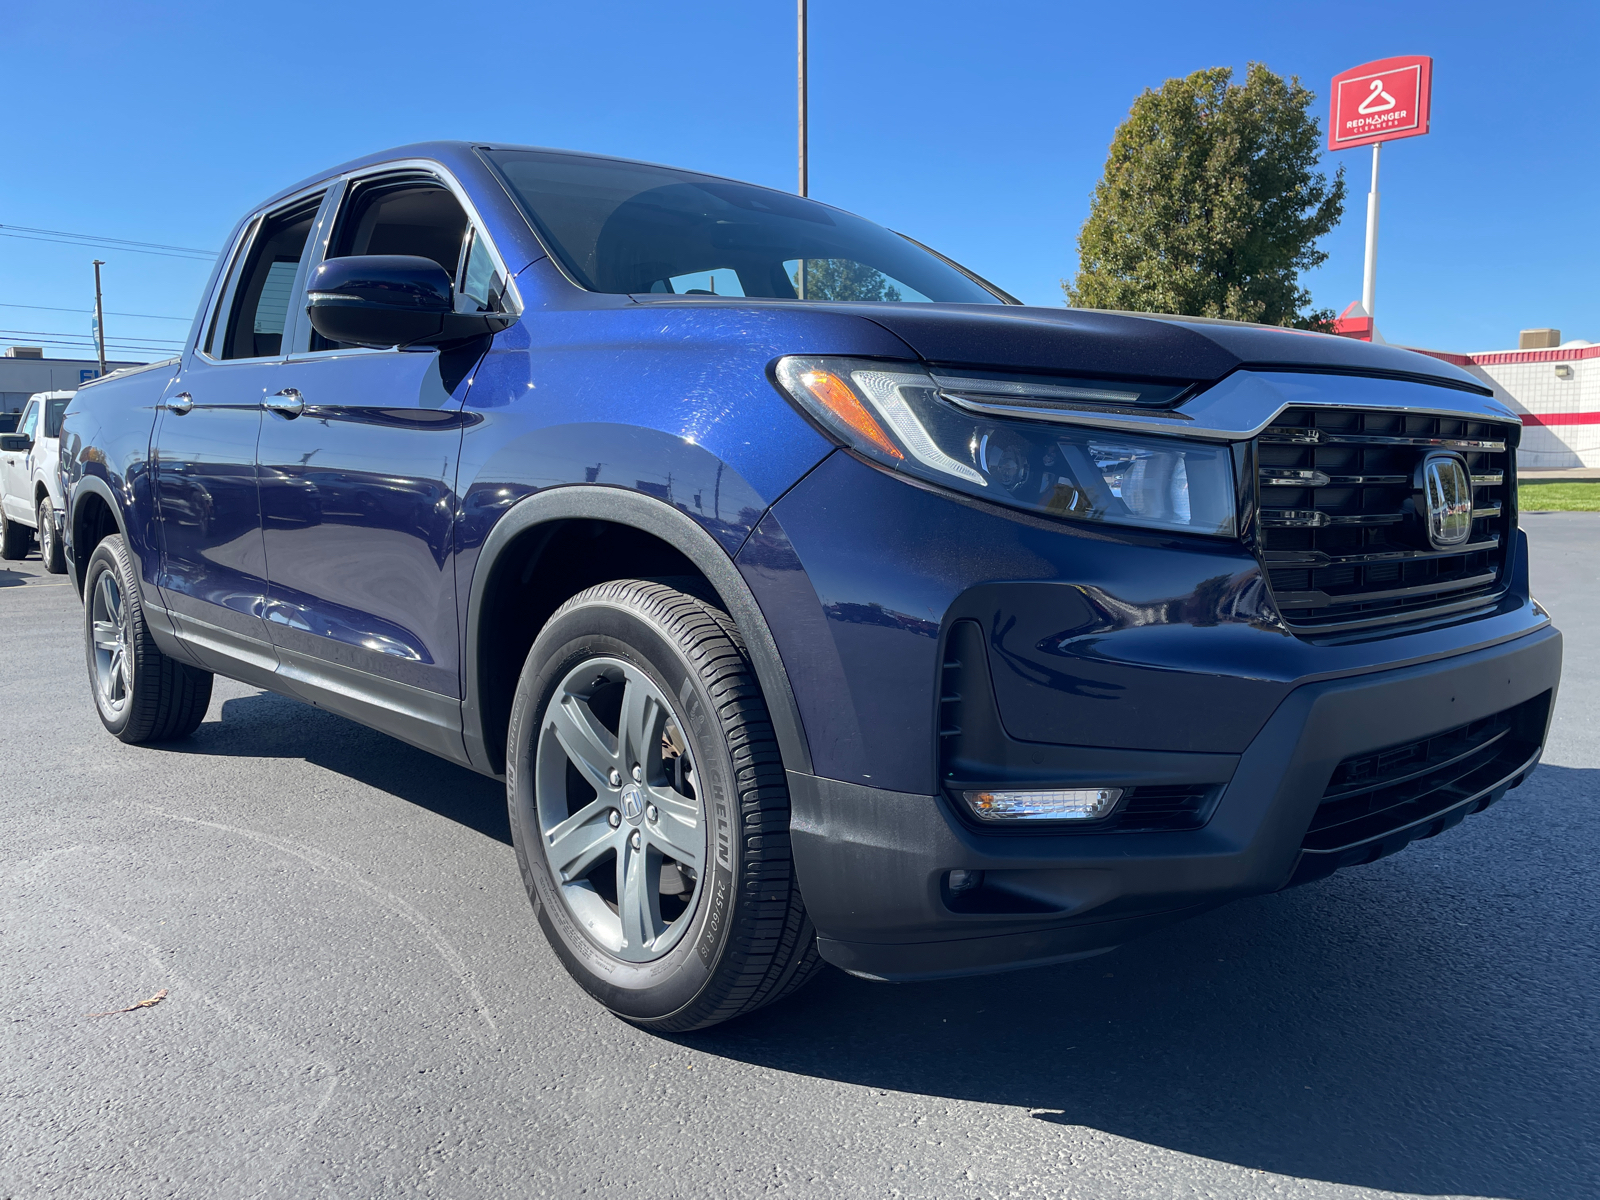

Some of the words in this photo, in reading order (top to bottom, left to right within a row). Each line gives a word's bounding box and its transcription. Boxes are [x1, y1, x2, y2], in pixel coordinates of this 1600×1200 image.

[1346, 119, 1364, 129] RED
[1353, 120, 1399, 133] CLEANERS
[711, 880, 726, 931] 245/60
[706, 931, 715, 944] R
